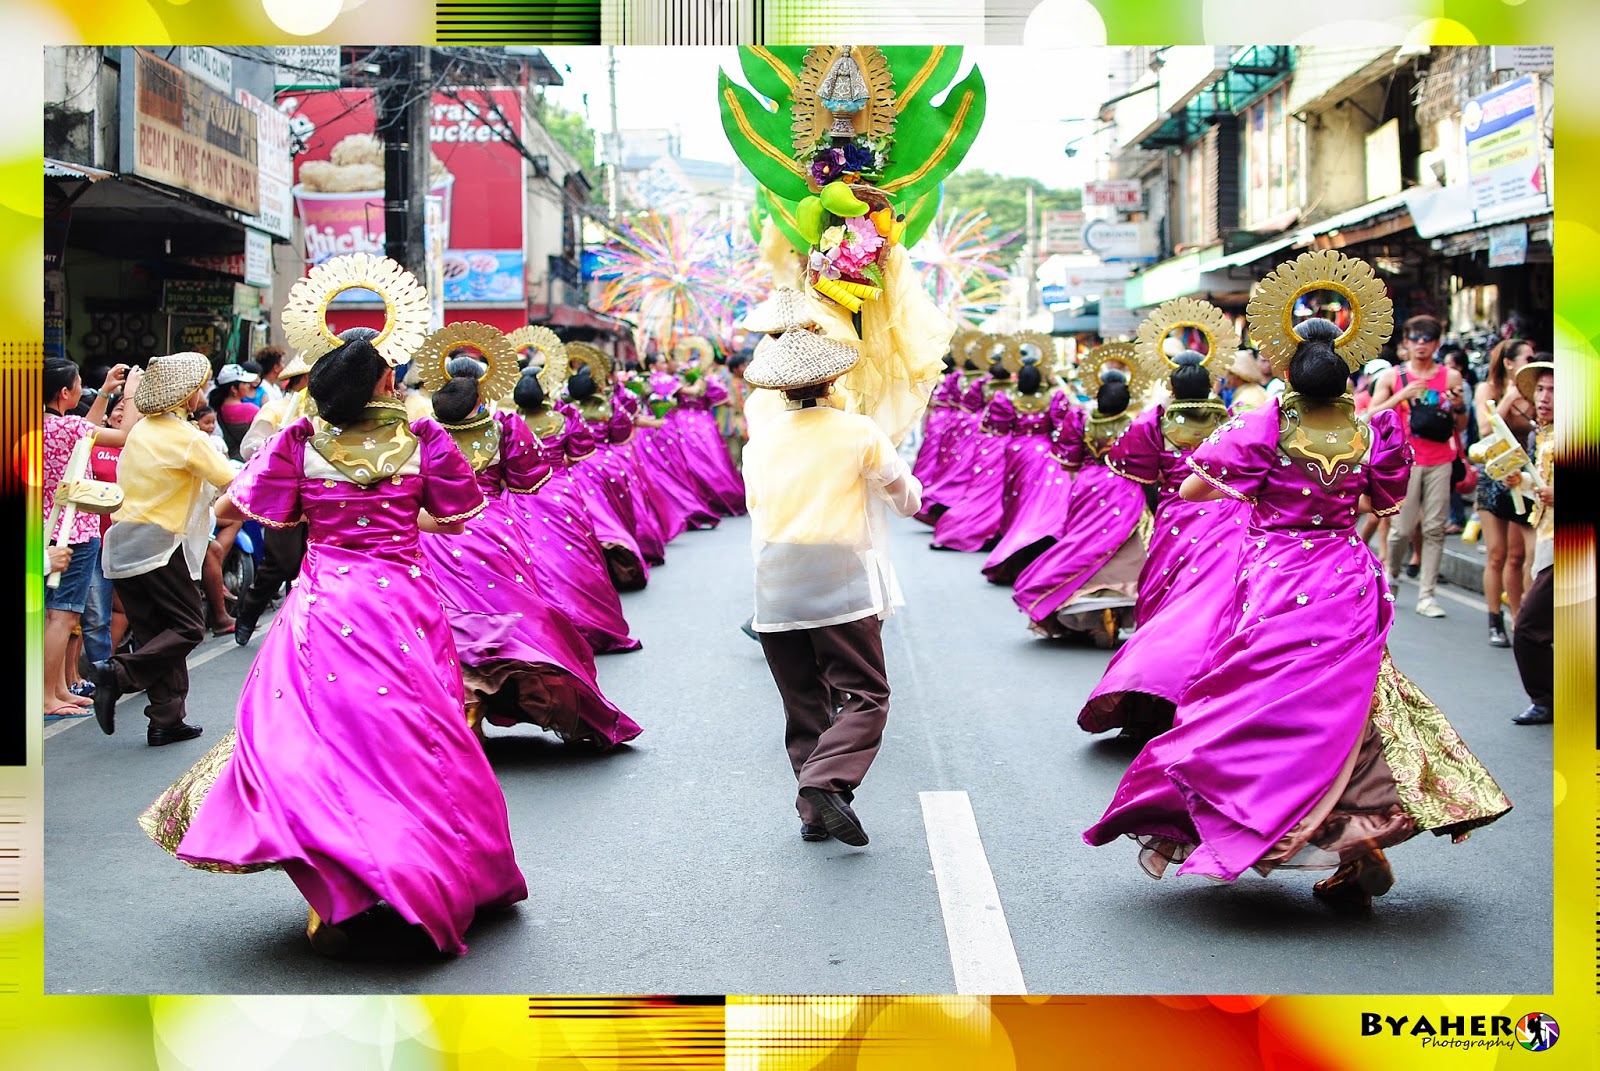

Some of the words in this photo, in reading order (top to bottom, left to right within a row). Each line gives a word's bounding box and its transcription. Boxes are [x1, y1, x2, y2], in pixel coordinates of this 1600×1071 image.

[430, 101, 480, 121] rab
[173, 136, 199, 181] HOME
[231, 161, 257, 205] SUPPLY
